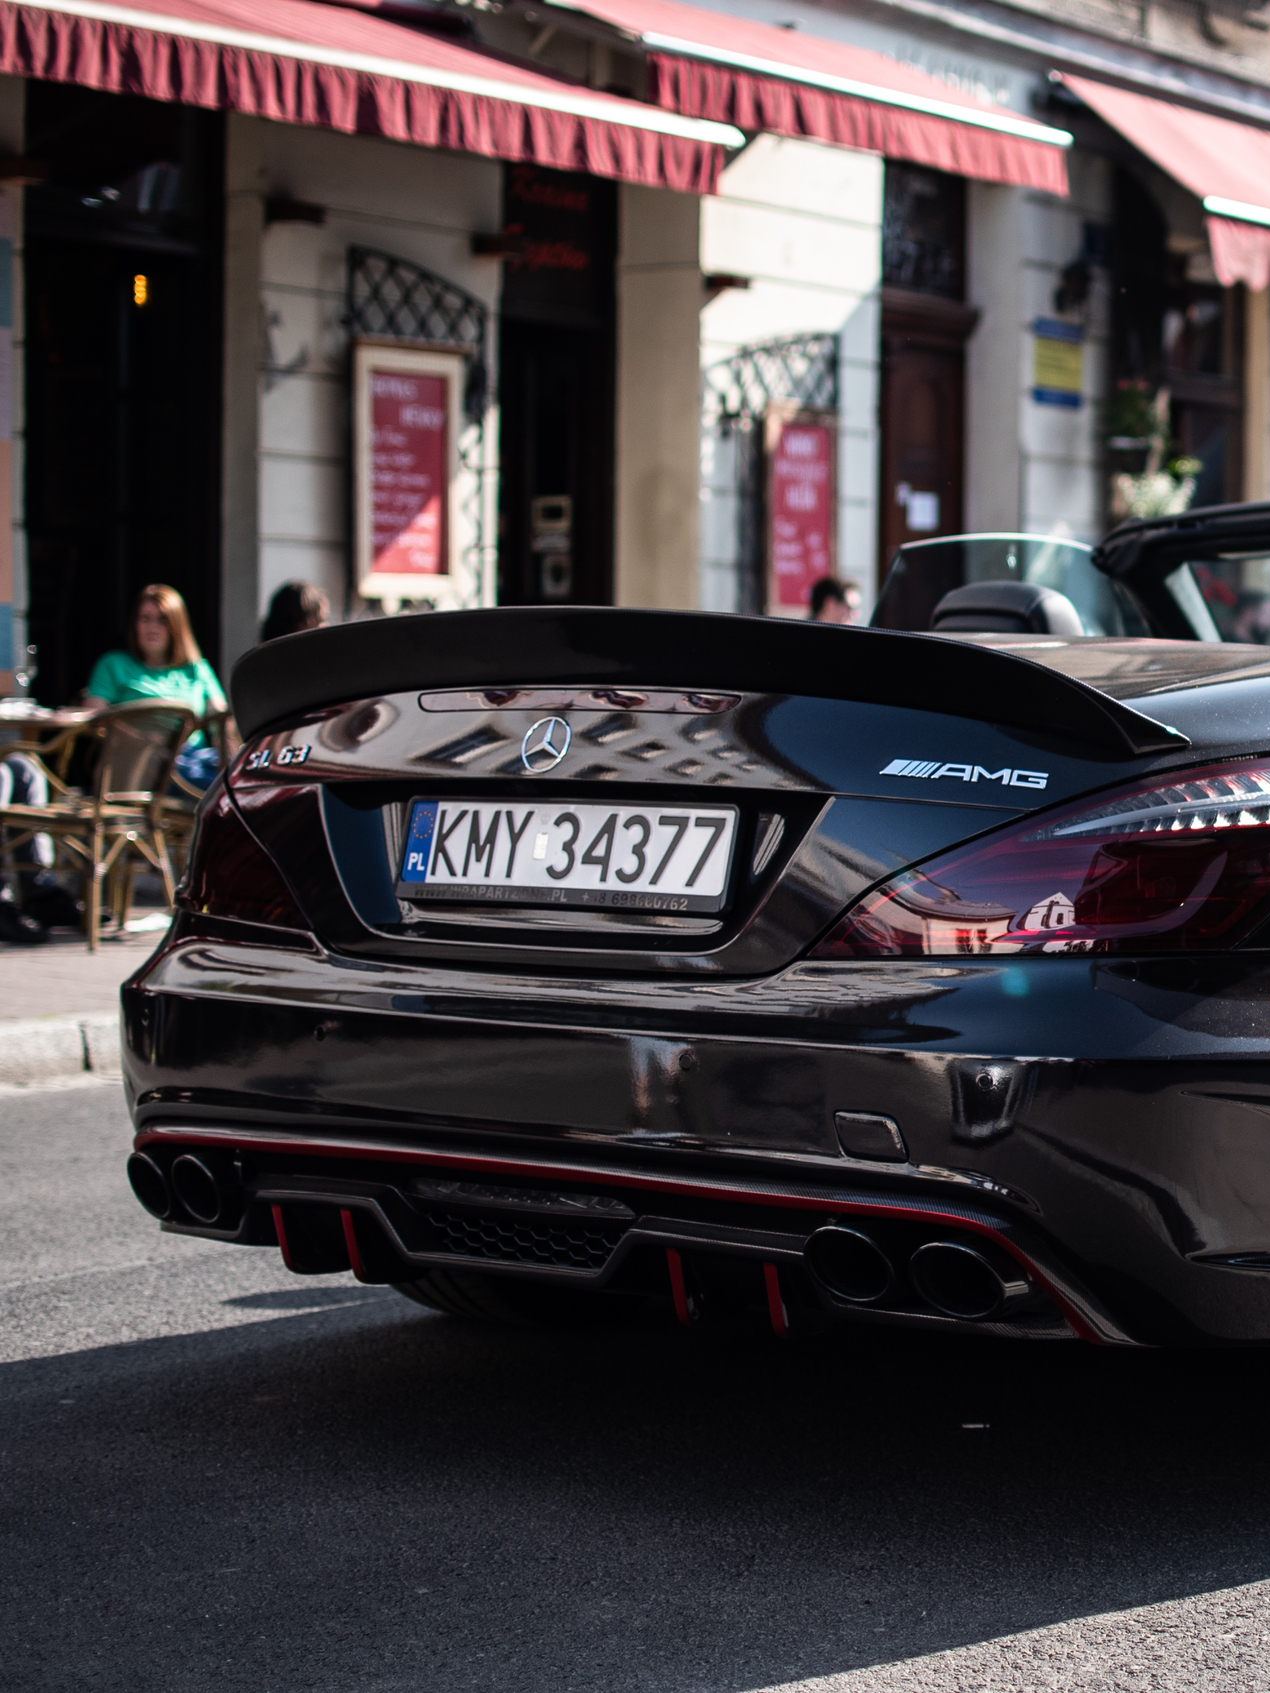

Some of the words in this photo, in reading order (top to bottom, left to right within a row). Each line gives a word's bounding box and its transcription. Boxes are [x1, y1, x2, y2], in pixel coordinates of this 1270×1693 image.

[245, 748, 270, 771] SL
[276, 744, 311, 766] 63
[930, 762, 1050, 790] AMG
[429, 808, 535, 879] KMY
[545, 811, 728, 888] 34377
[406, 852, 426, 872] PL
